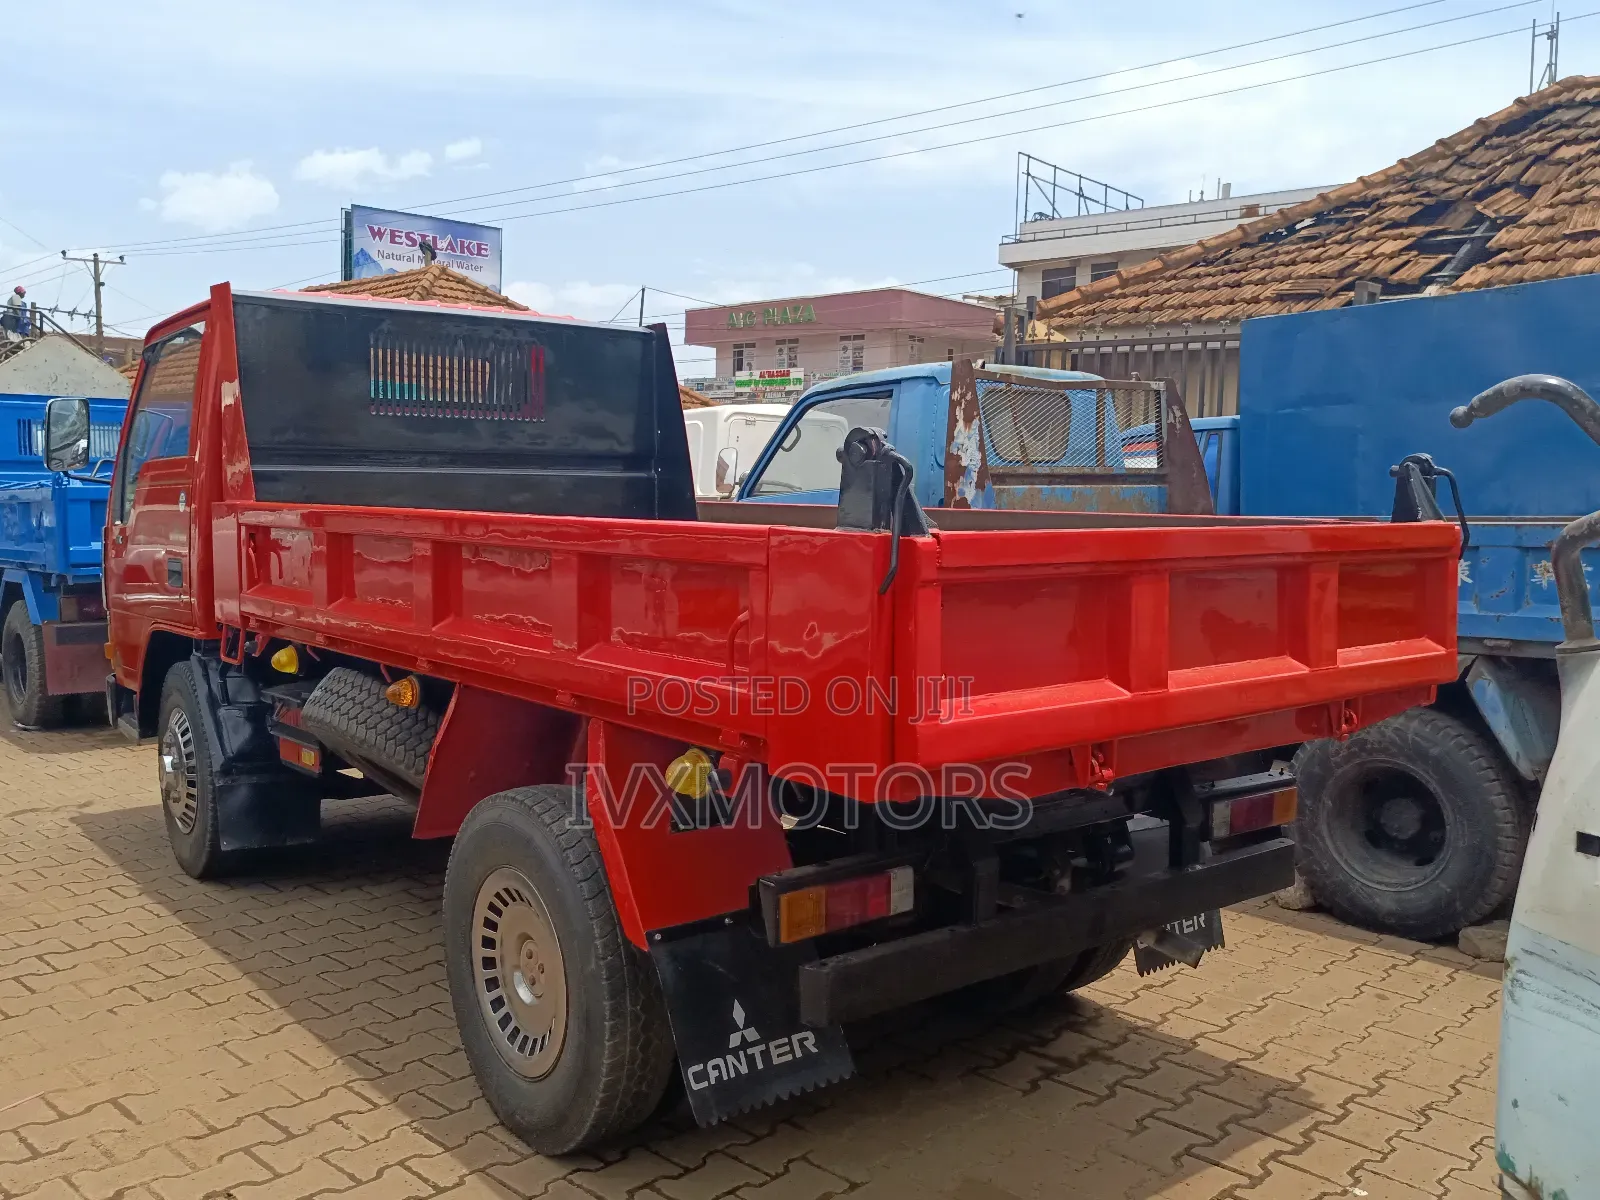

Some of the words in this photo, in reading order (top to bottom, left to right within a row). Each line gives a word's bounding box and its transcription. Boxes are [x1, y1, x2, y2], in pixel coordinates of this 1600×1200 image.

[377, 249, 414, 264] Natural
[456, 260, 484, 273] Water
[762, 304, 816, 326] PLAZA
[687, 1030, 819, 1091] CANTER
